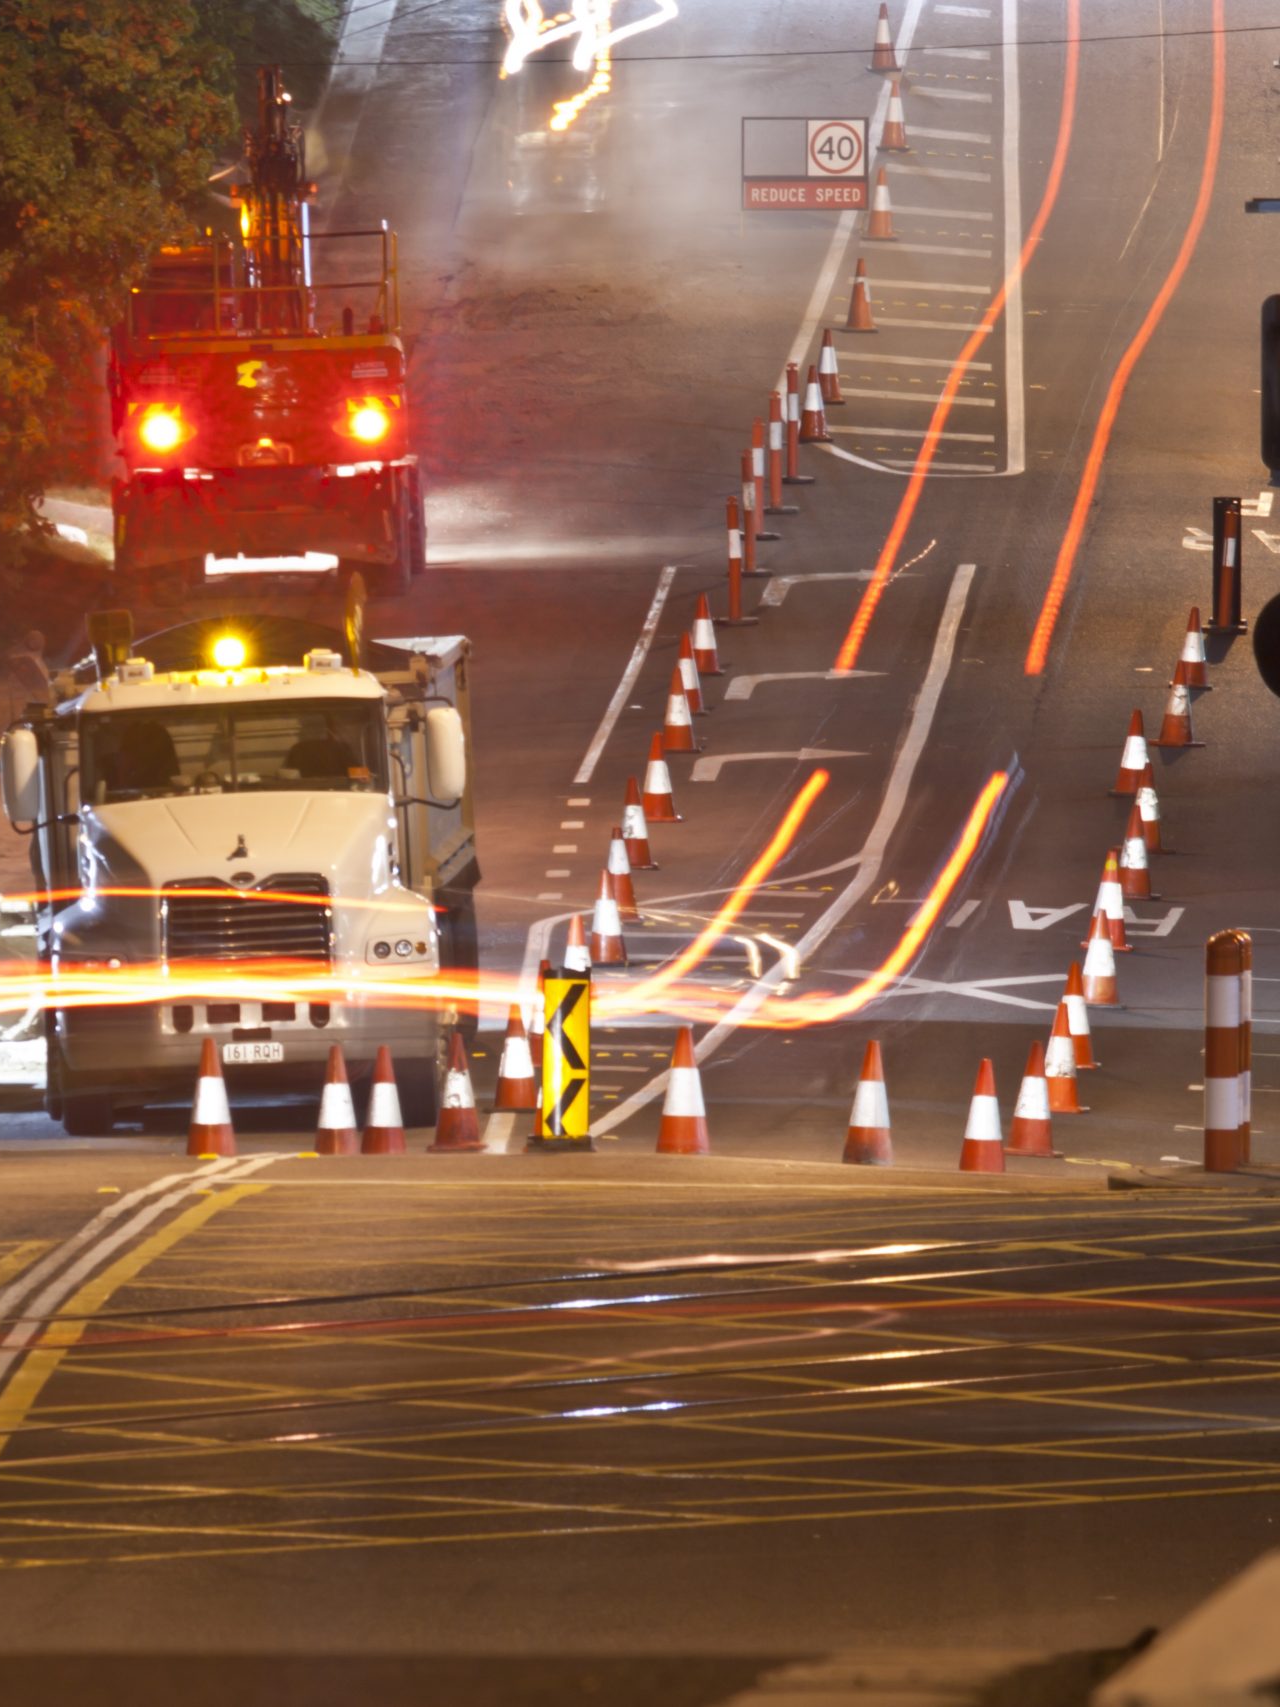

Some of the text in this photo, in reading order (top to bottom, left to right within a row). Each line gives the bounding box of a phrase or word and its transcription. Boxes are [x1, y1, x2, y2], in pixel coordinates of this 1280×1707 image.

[817, 136, 854, 160] 40
[751, 187, 861, 202] REDUCE SPEED
